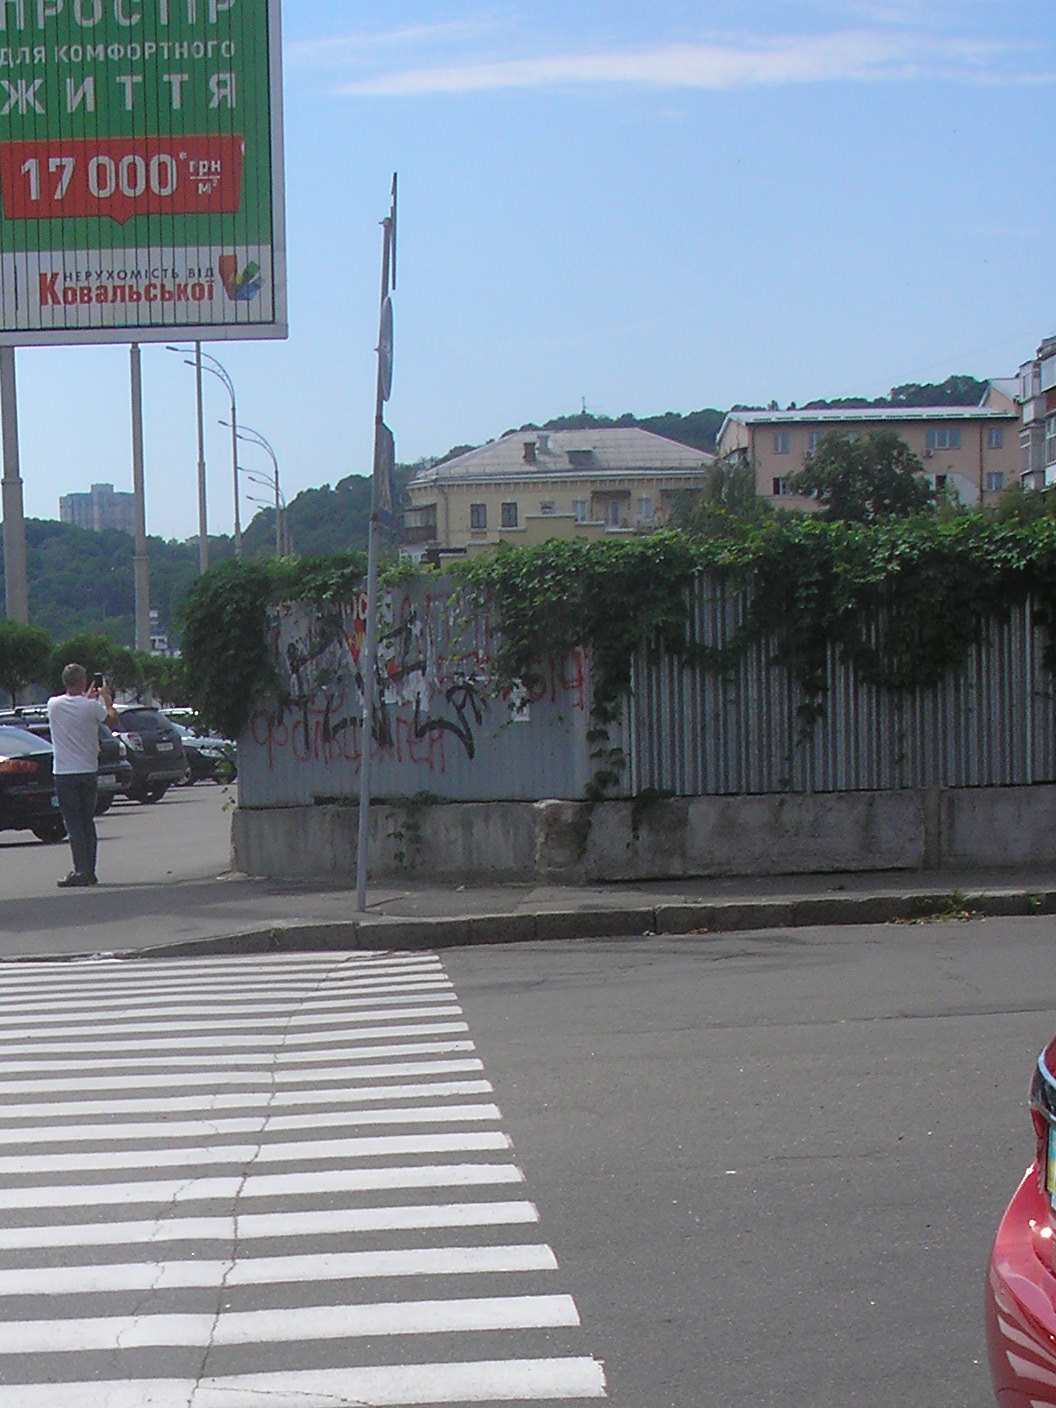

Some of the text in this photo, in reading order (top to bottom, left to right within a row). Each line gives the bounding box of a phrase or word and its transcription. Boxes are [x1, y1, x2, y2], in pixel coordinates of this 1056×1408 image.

[0, 73, 236, 115] ЖИТТЯ
[21, 157, 76, 200] 17
[189, 160, 221, 176] грн
[39, 272, 216, 306] Ковальської
[63, 267, 214, 282] НЕРУХОМІСТЬ ВІД
